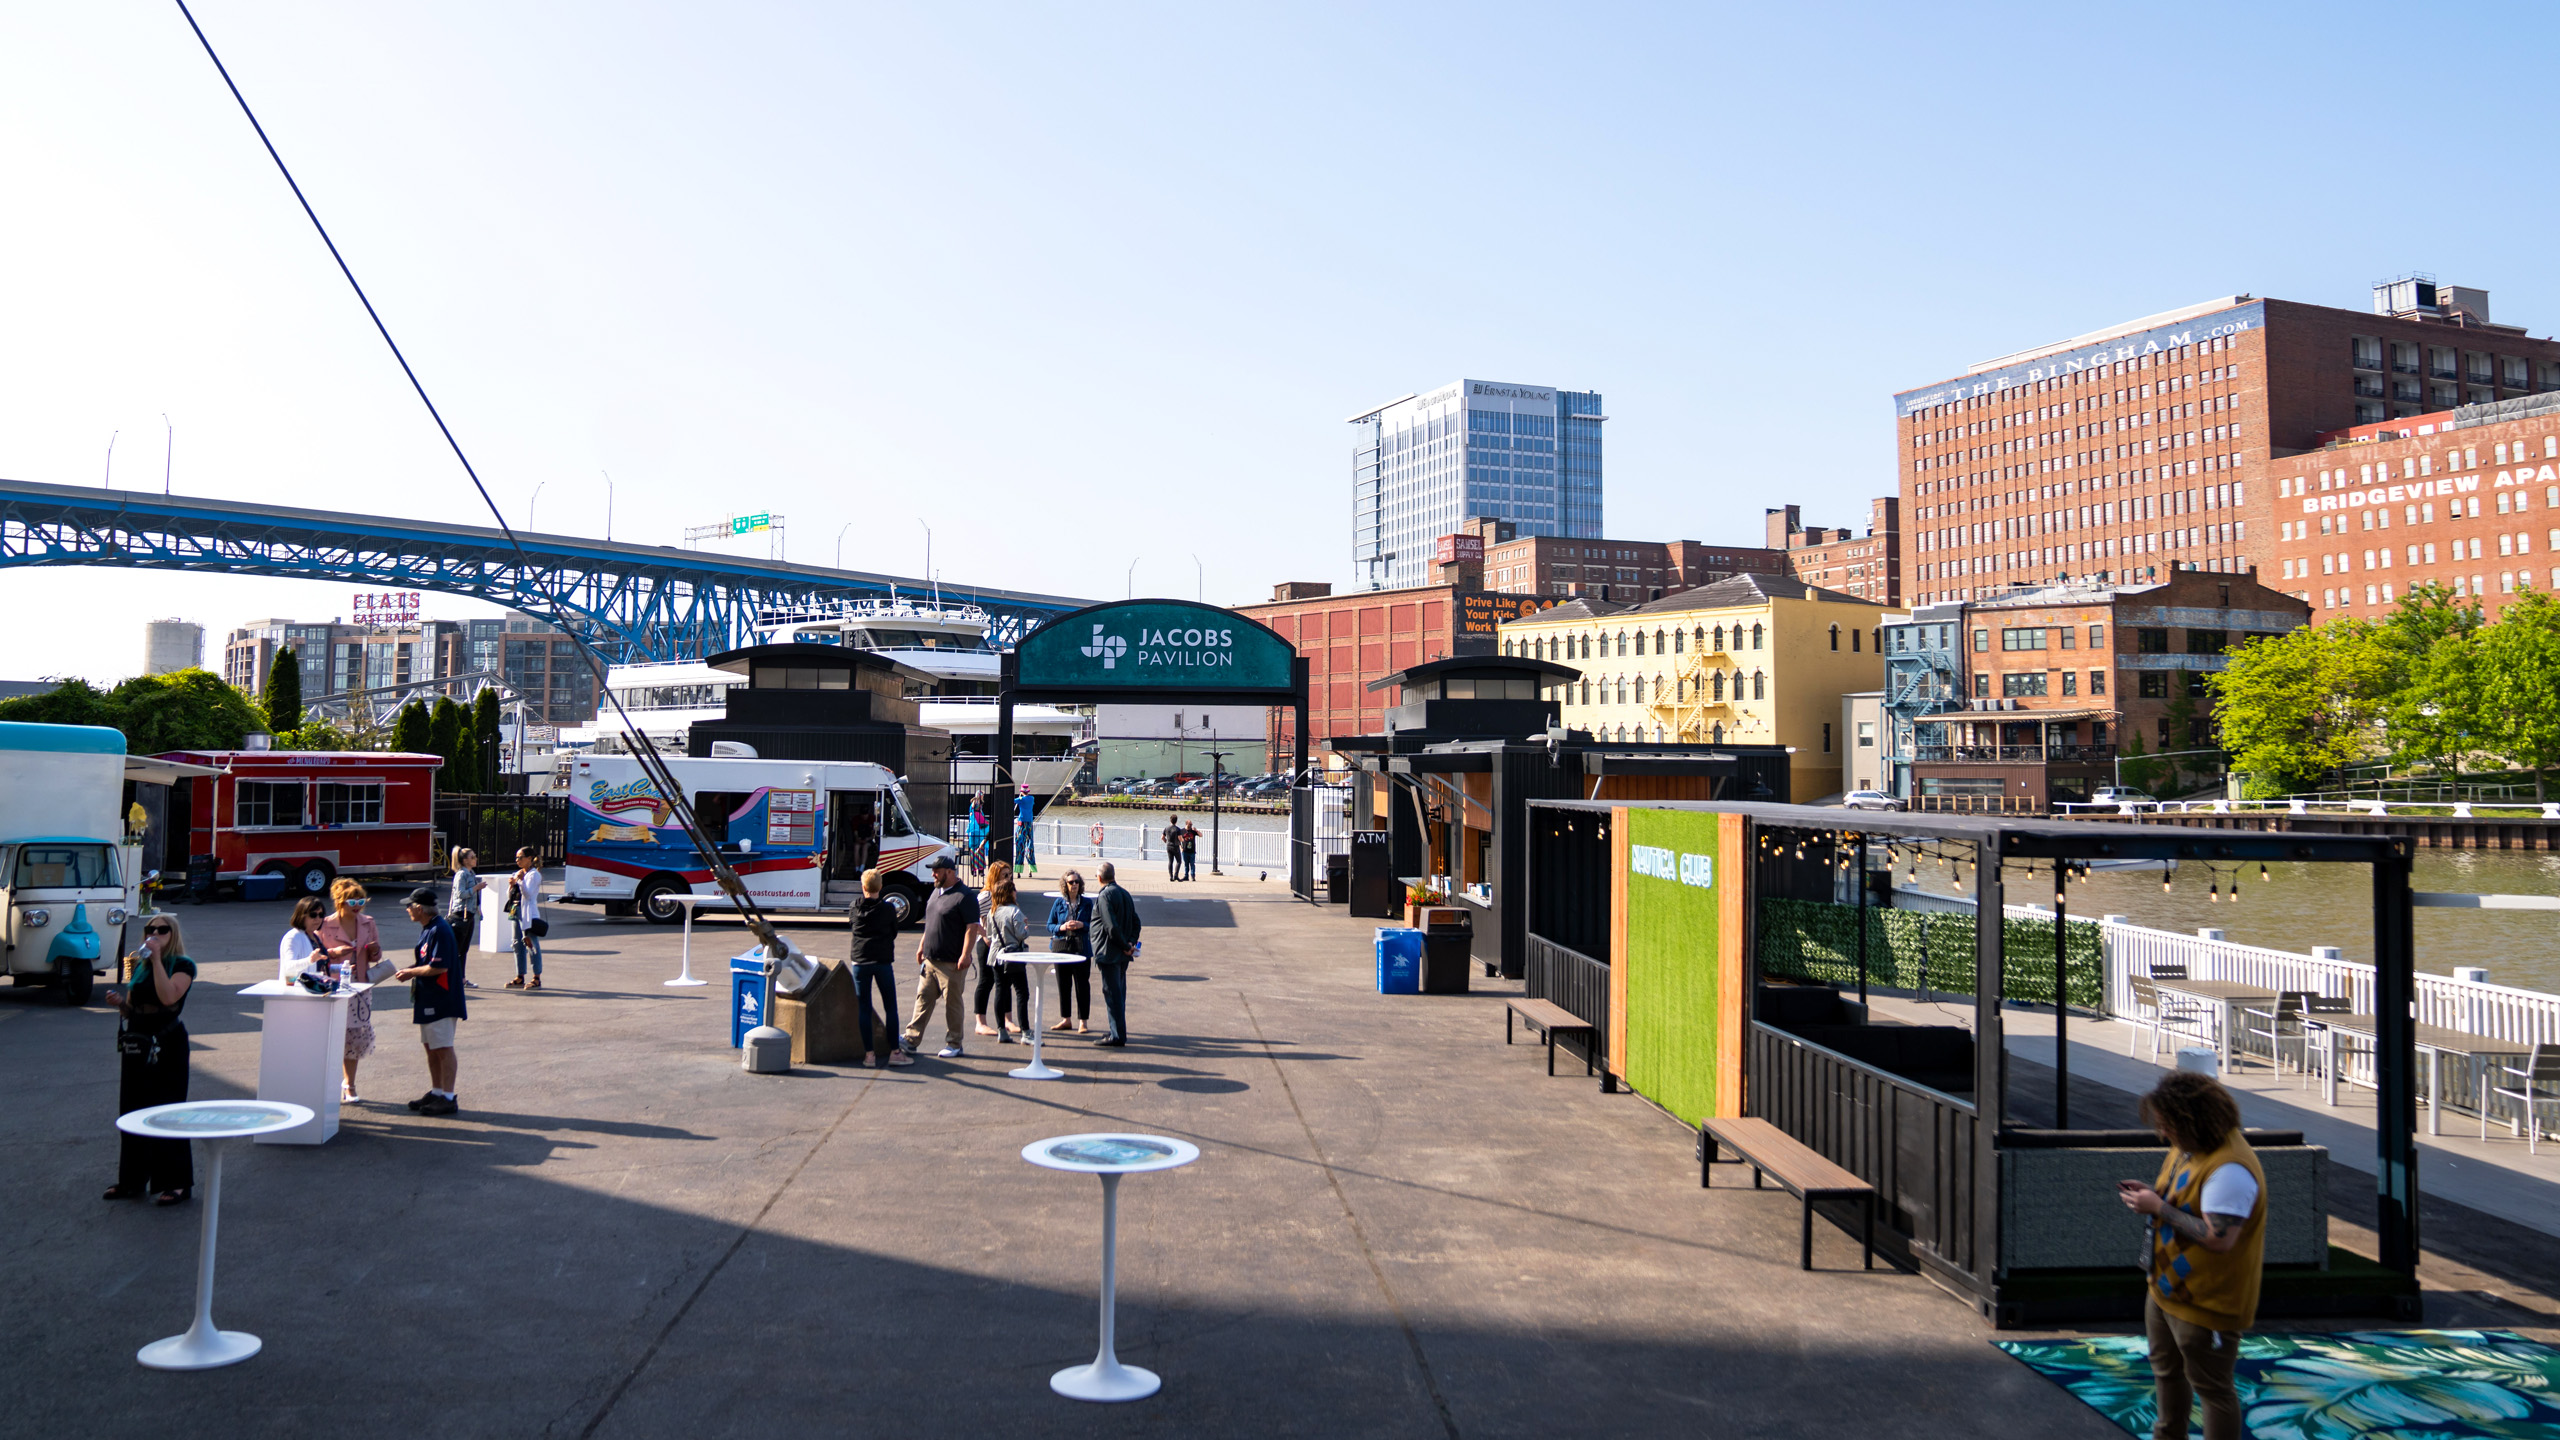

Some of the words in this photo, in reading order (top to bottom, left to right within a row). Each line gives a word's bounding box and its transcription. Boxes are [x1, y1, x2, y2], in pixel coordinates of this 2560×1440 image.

[1951, 376, 2010, 401] THE
[2029, 331, 2192, 382] BINGHAM
[1484, 385, 1510, 397] ERNST
[1519, 387, 1550, 401] YOUNG
[1906, 398, 1945, 412] APARTMENTS
[2303, 475, 2480, 513] BRIDGEVIEW
[2494, 463, 2560, 488] APA
[353, 592, 419, 610] FLATS
[1465, 597, 1492, 607] Drive
[1496, 598, 1516, 608] Like
[353, 614, 382, 624] EAST
[1465, 609, 1489, 620] Your
[1493, 610, 1515, 619] Kids
[1465, 621, 1492, 632] Work
[1138, 628, 1233, 648] JACOBS
[1138, 651, 1232, 667] PAVILION
[589, 780, 628, 802] East
[1357, 833, 1386, 844] ATM
[1631, 844, 1677, 882] NAUTICA
[1680, 852, 1713, 889] CLUB
